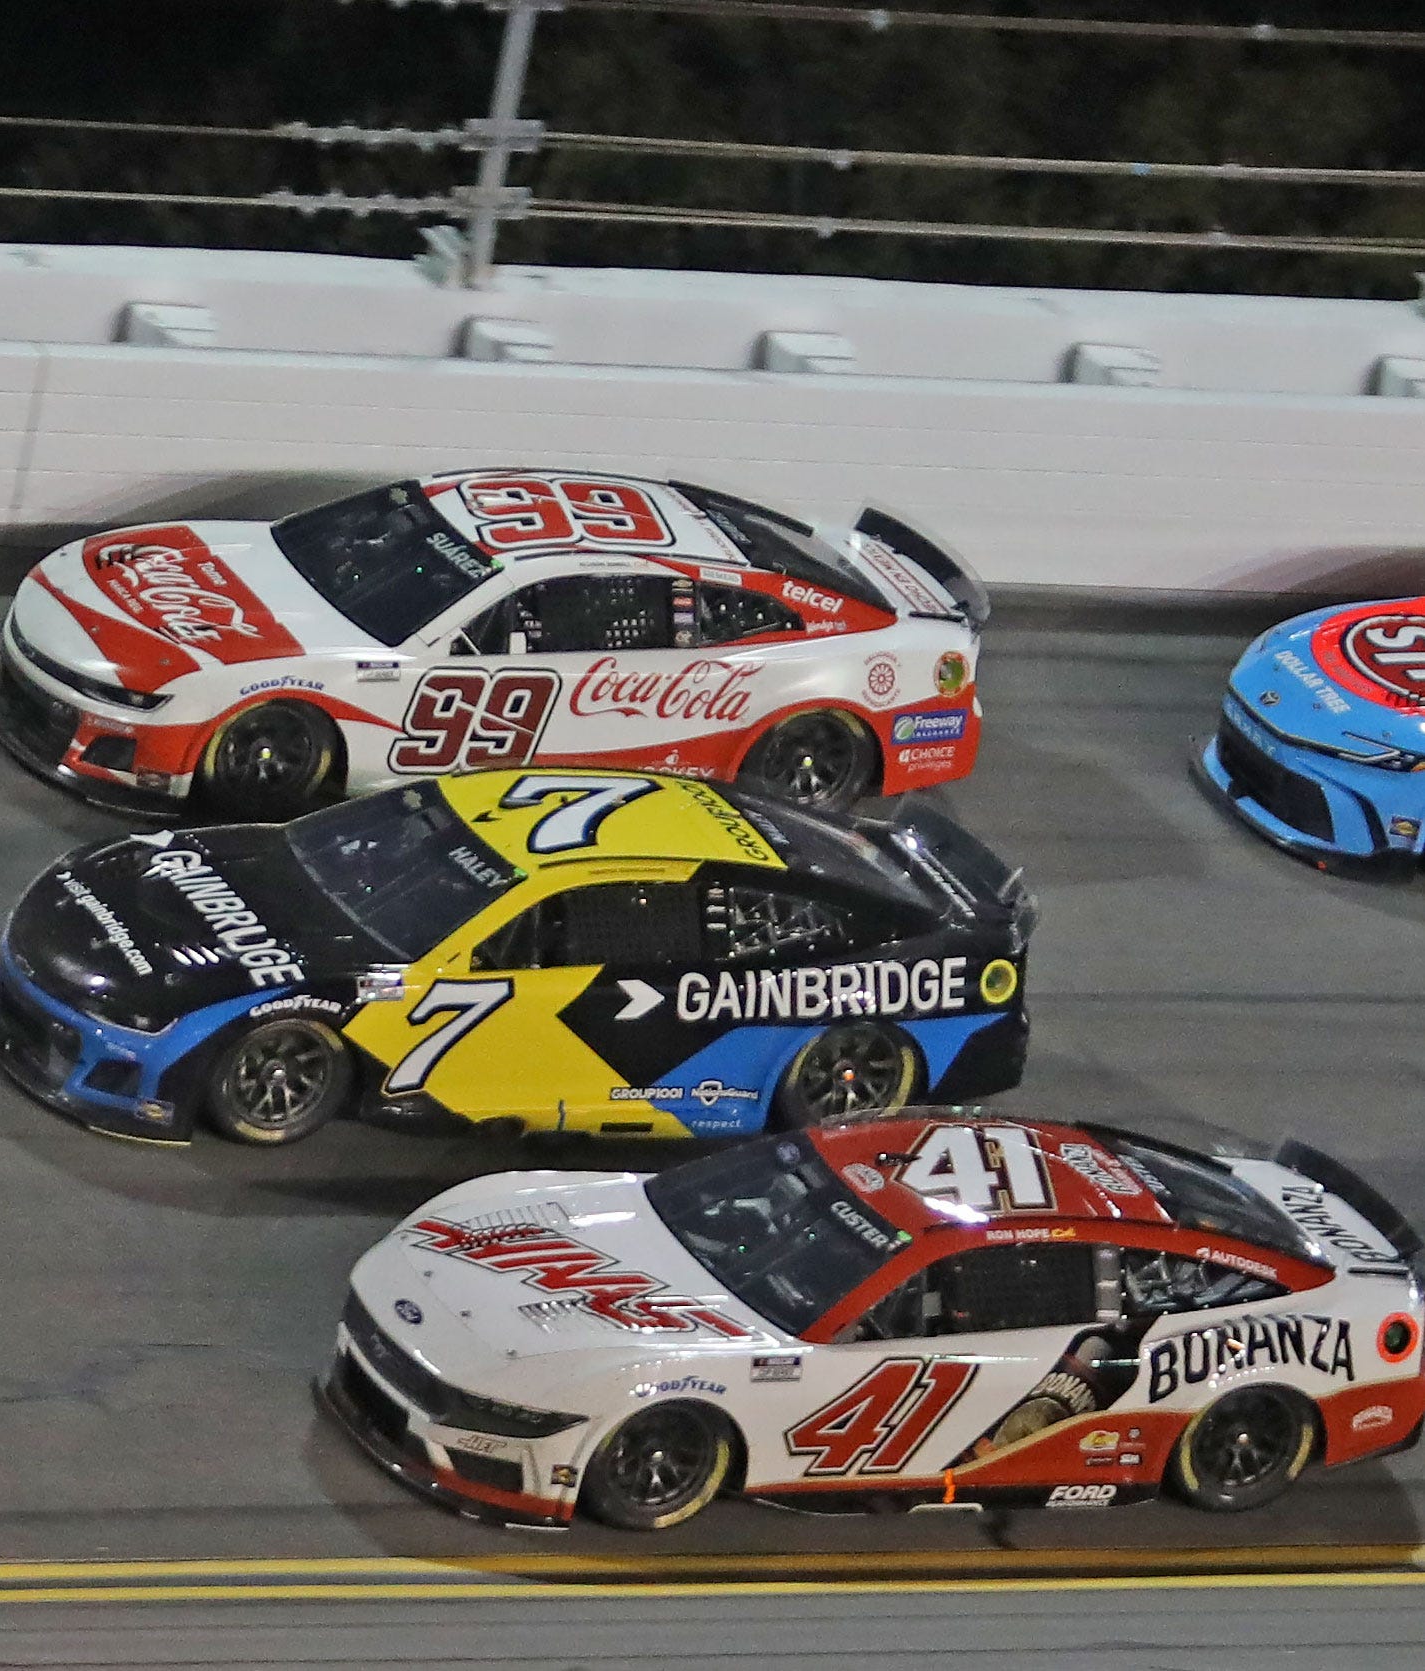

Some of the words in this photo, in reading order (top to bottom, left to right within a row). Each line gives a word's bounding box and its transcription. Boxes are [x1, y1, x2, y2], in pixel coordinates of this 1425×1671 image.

[456, 477, 676, 549] 99
[781, 580, 843, 613] telcel
[239, 675, 324, 695] GOODYEAR
[570, 657, 763, 722] Coca-Cola
[387, 666, 563, 776] 99
[911, 746, 955, 760] CHOICE
[914, 715, 963, 730] Freeway
[498, 774, 664, 854] 7
[449, 846, 509, 887] HALEY
[149, 849, 306, 989] GAINBRIDGE
[249, 994, 342, 1017] GOODYEAR
[676, 957, 967, 1022] GAINBRIDGE
[381, 978, 515, 1099] 7
[892, 1121, 1058, 1216] 41
[831, 1201, 890, 1248] CUSTER
[986, 1229, 1014, 1240] RON
[1016, 1228, 1050, 1239] HOPE
[1282, 1185, 1401, 1262] BONANZA
[1212, 1249, 1277, 1280] AUTODESK
[1149, 1314, 1355, 1404] BONANZA
[783, 1356, 981, 1478] 41
[1049, 1485, 1117, 1500] FORD
